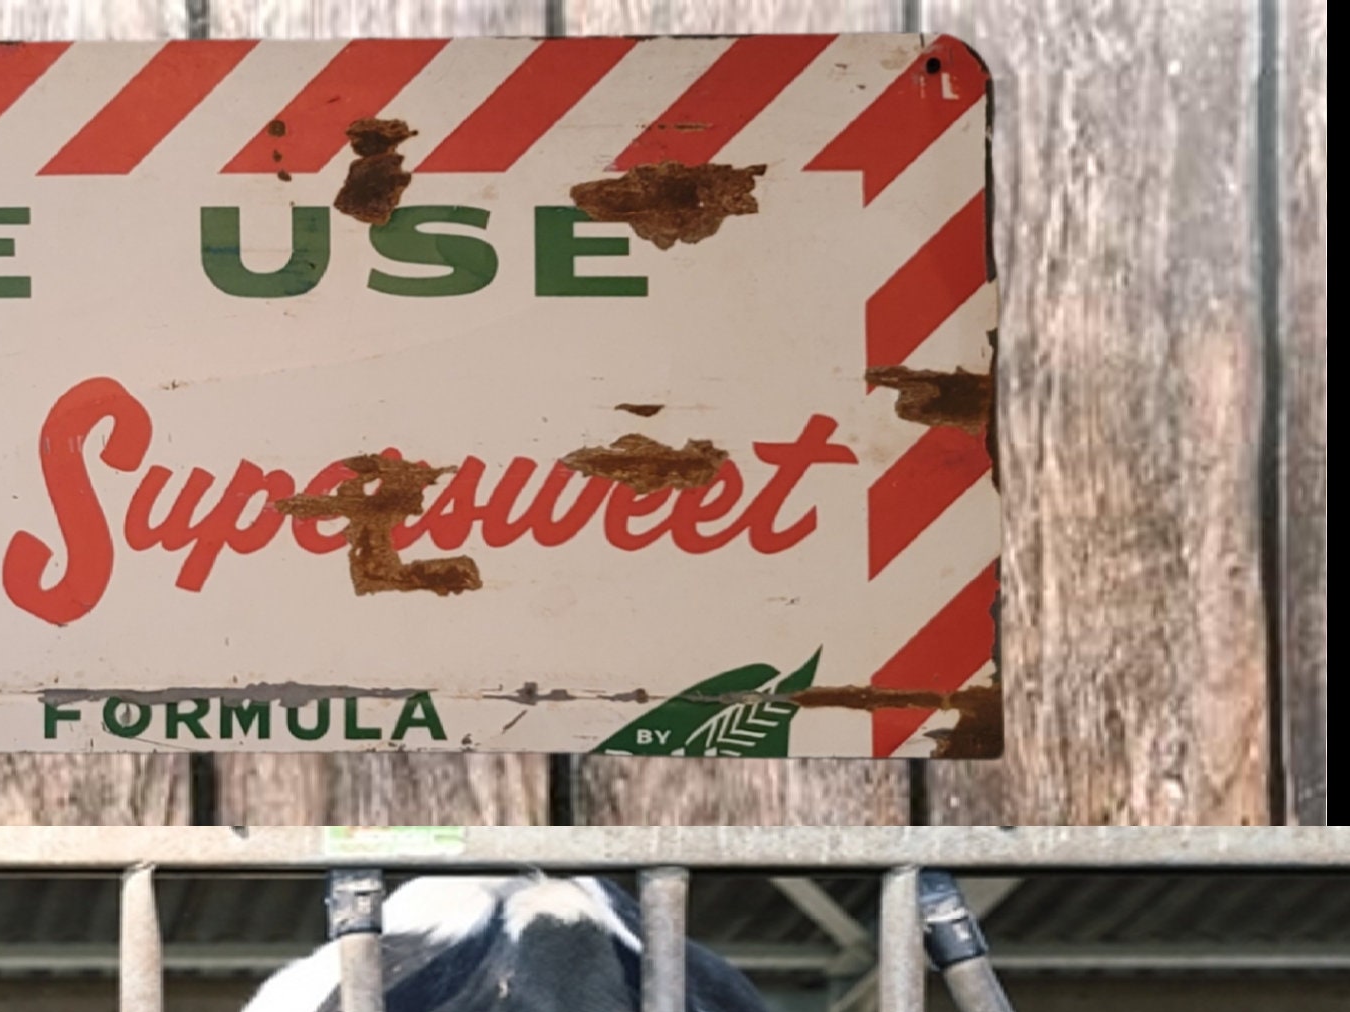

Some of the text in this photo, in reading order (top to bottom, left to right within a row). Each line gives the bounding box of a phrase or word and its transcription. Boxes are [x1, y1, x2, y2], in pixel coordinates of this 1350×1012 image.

[200, 204, 649, 298] USE
[3, 376, 860, 626] Supesweet
[42, 690, 448, 741] FORMULA
[636, 728, 672, 746] BY
